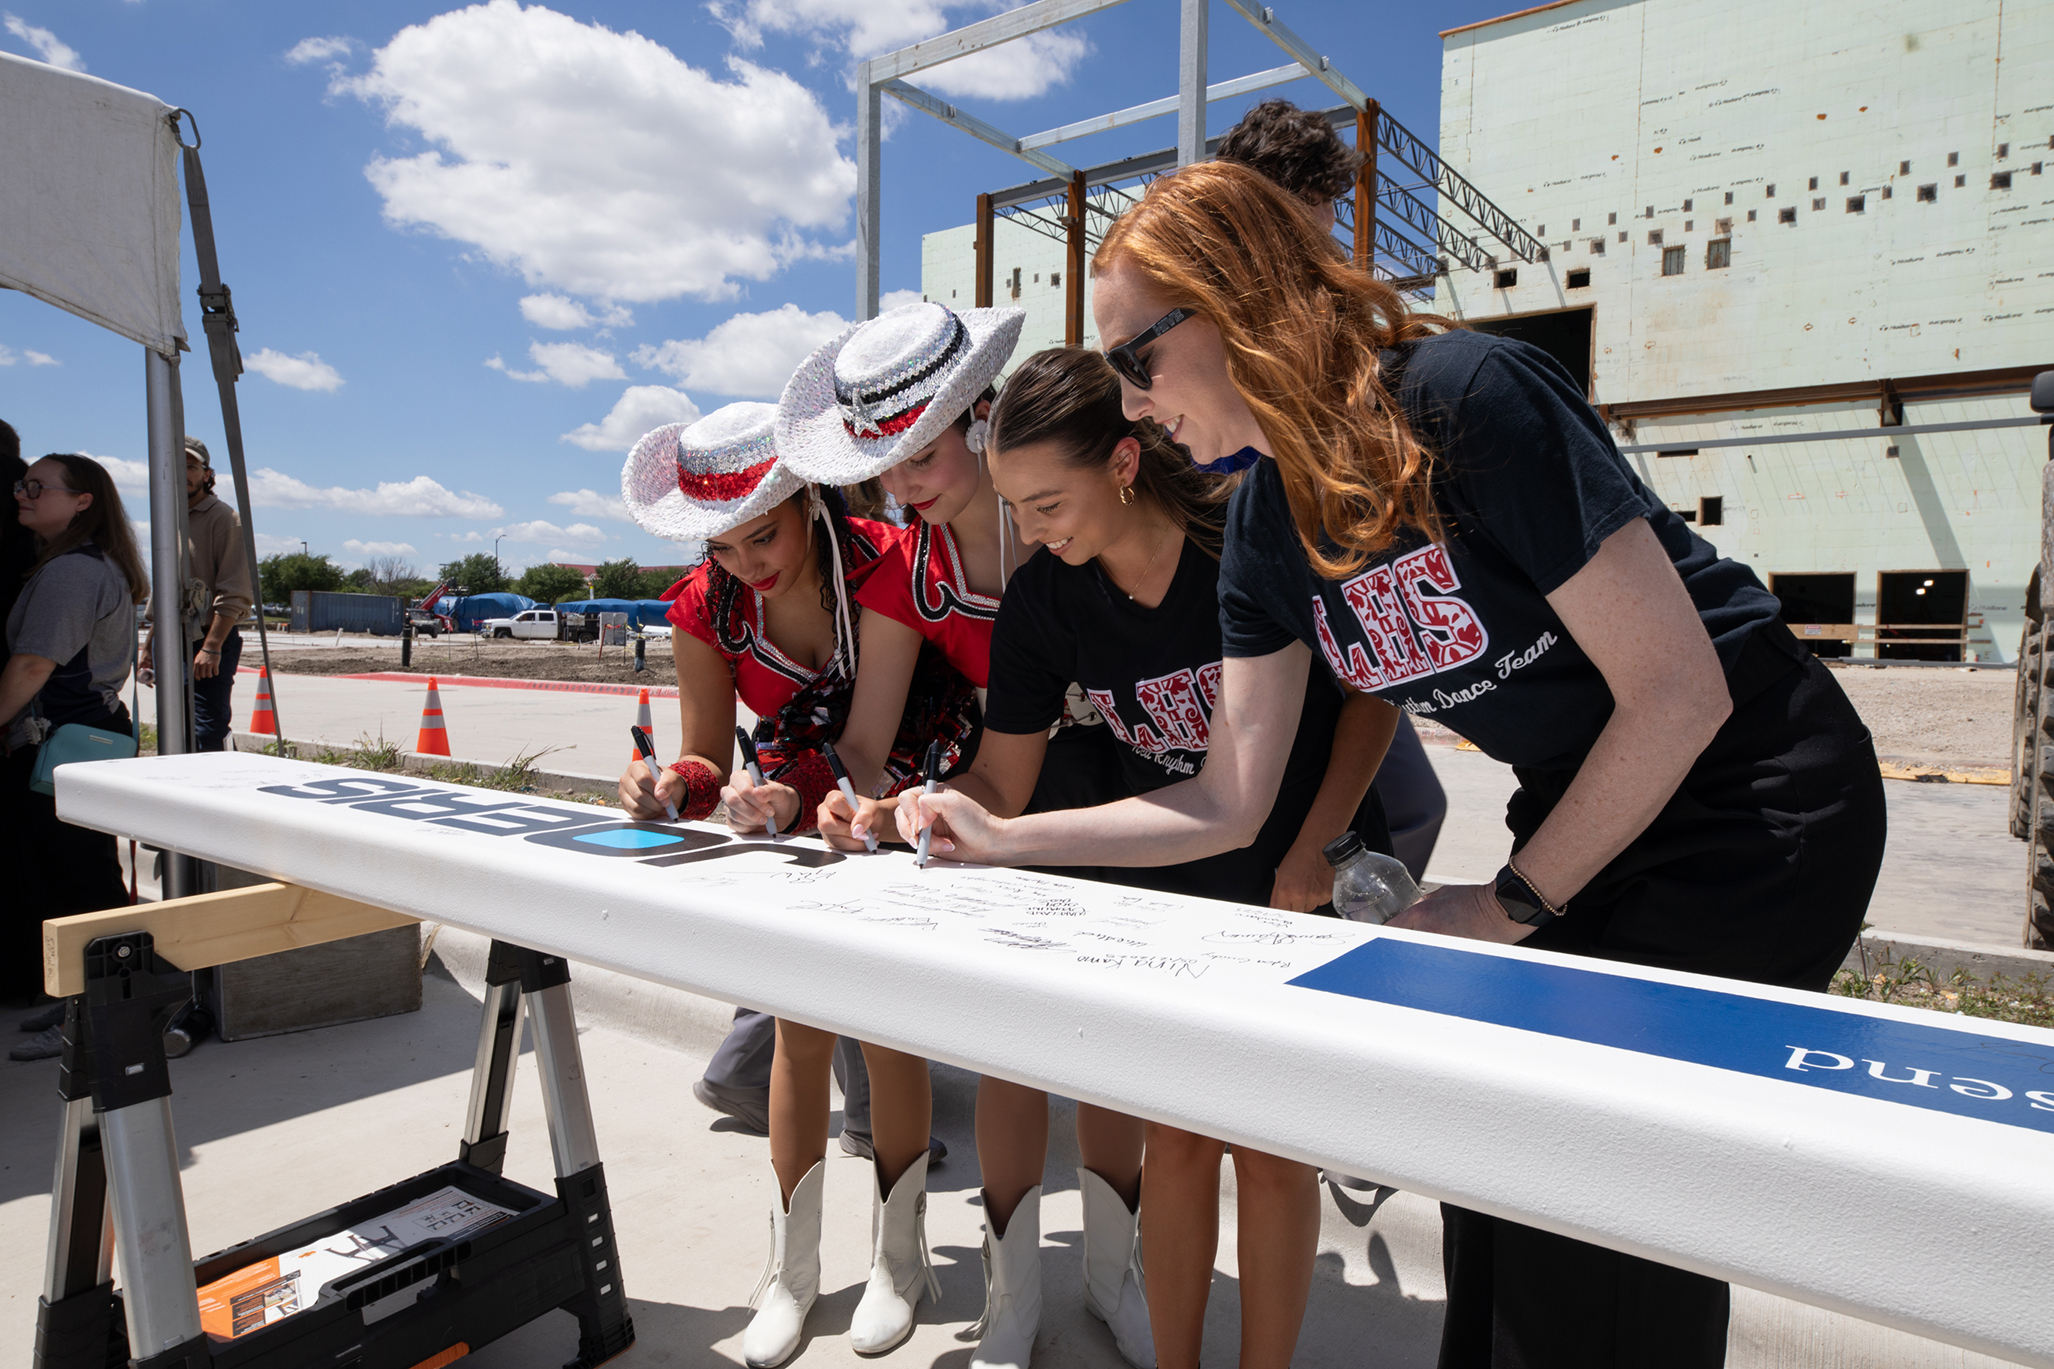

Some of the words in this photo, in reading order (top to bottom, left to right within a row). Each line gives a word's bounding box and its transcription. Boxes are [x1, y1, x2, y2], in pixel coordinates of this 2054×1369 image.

[1313, 541, 1489, 692] LHS
[1433, 679, 1497, 709] Dance
[1494, 630, 1558, 679] Team
[256, 777, 848, 868] JOERIS
[1134, 951, 1211, 979] Nina
